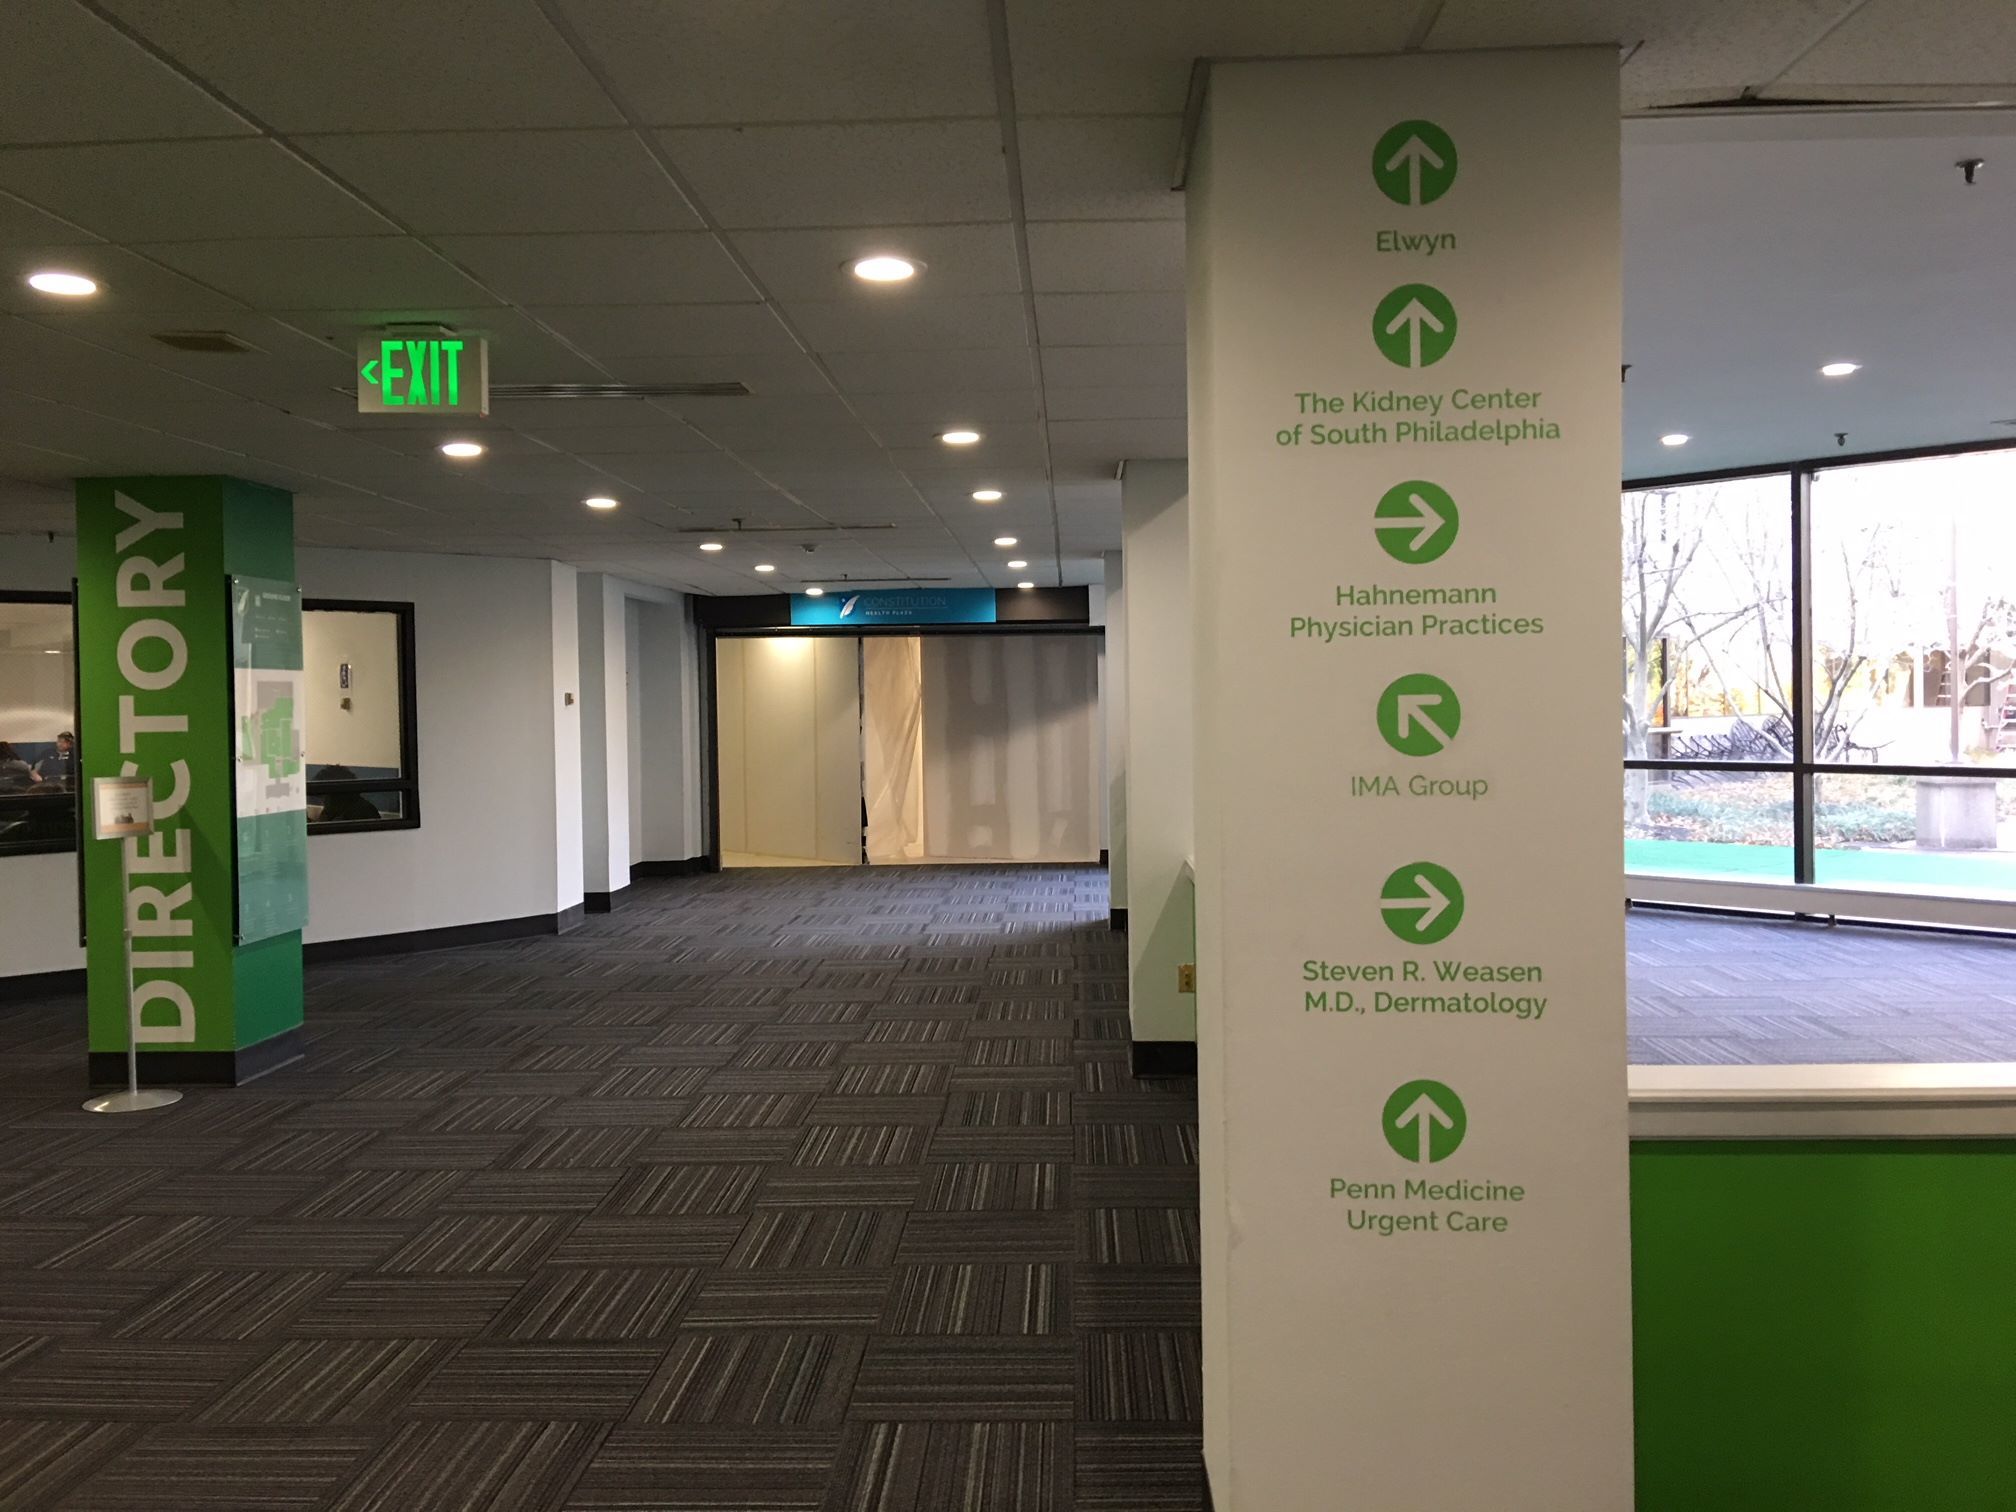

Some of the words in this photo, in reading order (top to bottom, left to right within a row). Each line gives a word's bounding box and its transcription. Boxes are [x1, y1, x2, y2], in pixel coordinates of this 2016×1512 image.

[1376, 230, 1456, 256] Elwyn
[381, 340, 464, 406] EXIT
[1294, 392, 1345, 414] The
[1352, 391, 1444, 417] Kidney
[1451, 388, 1542, 411] Center
[1275, 424, 1304, 446] of
[1310, 423, 1388, 445] South
[1396, 418, 1561, 446] Philadelphia
[1336, 584, 1497, 607] Hahnemann
[1290, 614, 1414, 644] Physician
[1421, 612, 1545, 637] Practices
[114, 489, 196, 1044] DIRECTORY
[1351, 775, 1401, 797] IMA
[1408, 774, 1489, 801] Group
[1302, 960, 1394, 982] Steven
[1402, 960, 1426, 982] R.
[1432, 960, 1543, 983] Weasen
[1304, 991, 1366, 1015] M.D.,
[1374, 991, 1548, 1020] Dermatology
[1330, 1177, 1396, 1200] Penn
[1404, 1178, 1526, 1202] Medicine
[1347, 1210, 1439, 1237] Urgent
[1445, 1210, 1509, 1233] Care
